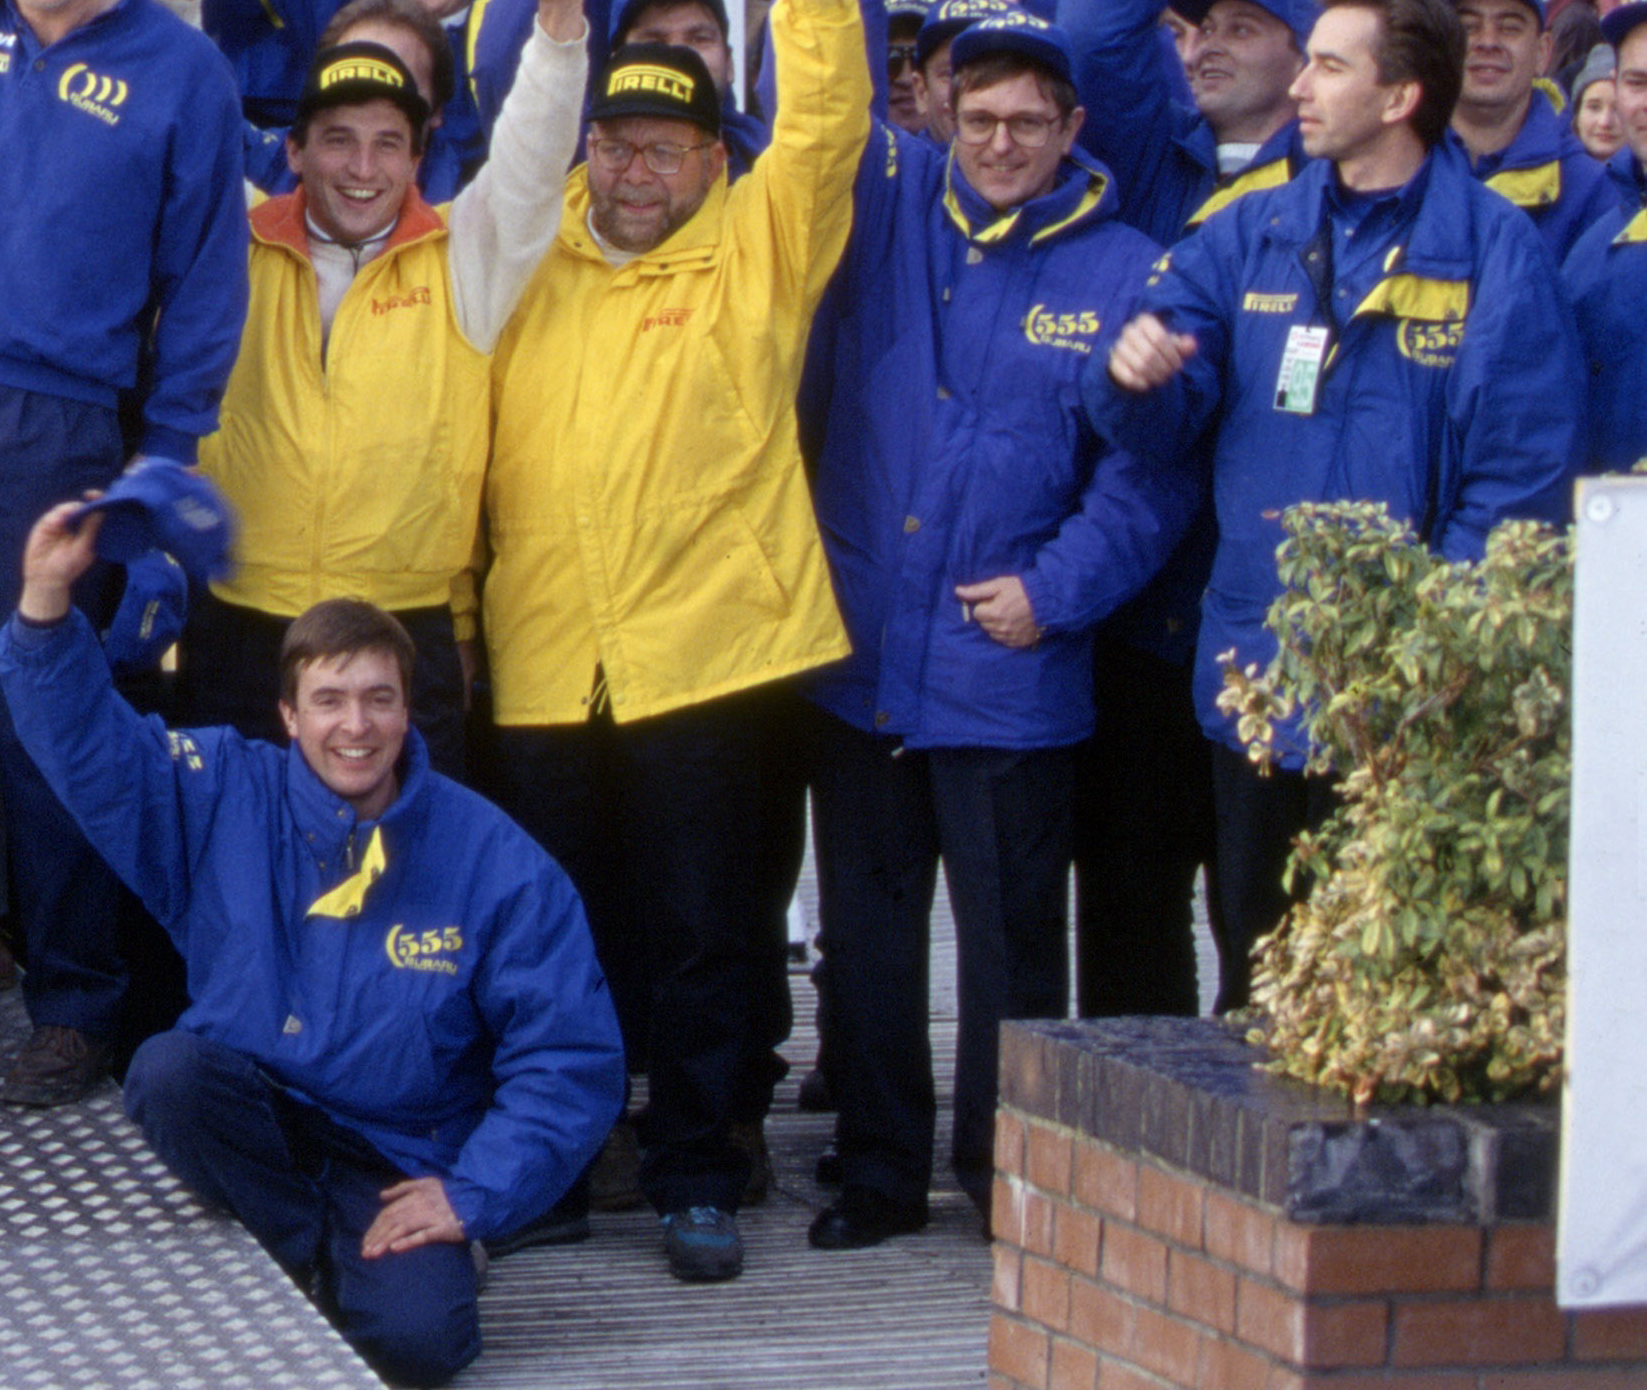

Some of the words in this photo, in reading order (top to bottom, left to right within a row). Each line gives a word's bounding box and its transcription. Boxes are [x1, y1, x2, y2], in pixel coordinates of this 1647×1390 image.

[319, 57, 404, 91] PIRELLI
[607, 64, 695, 104] PIRELLI
[1034, 311, 1100, 336] 555
[1409, 321, 1464, 350] 555
[1039, 333, 1092, 355] SUBARU
[398, 926, 464, 957] 555
